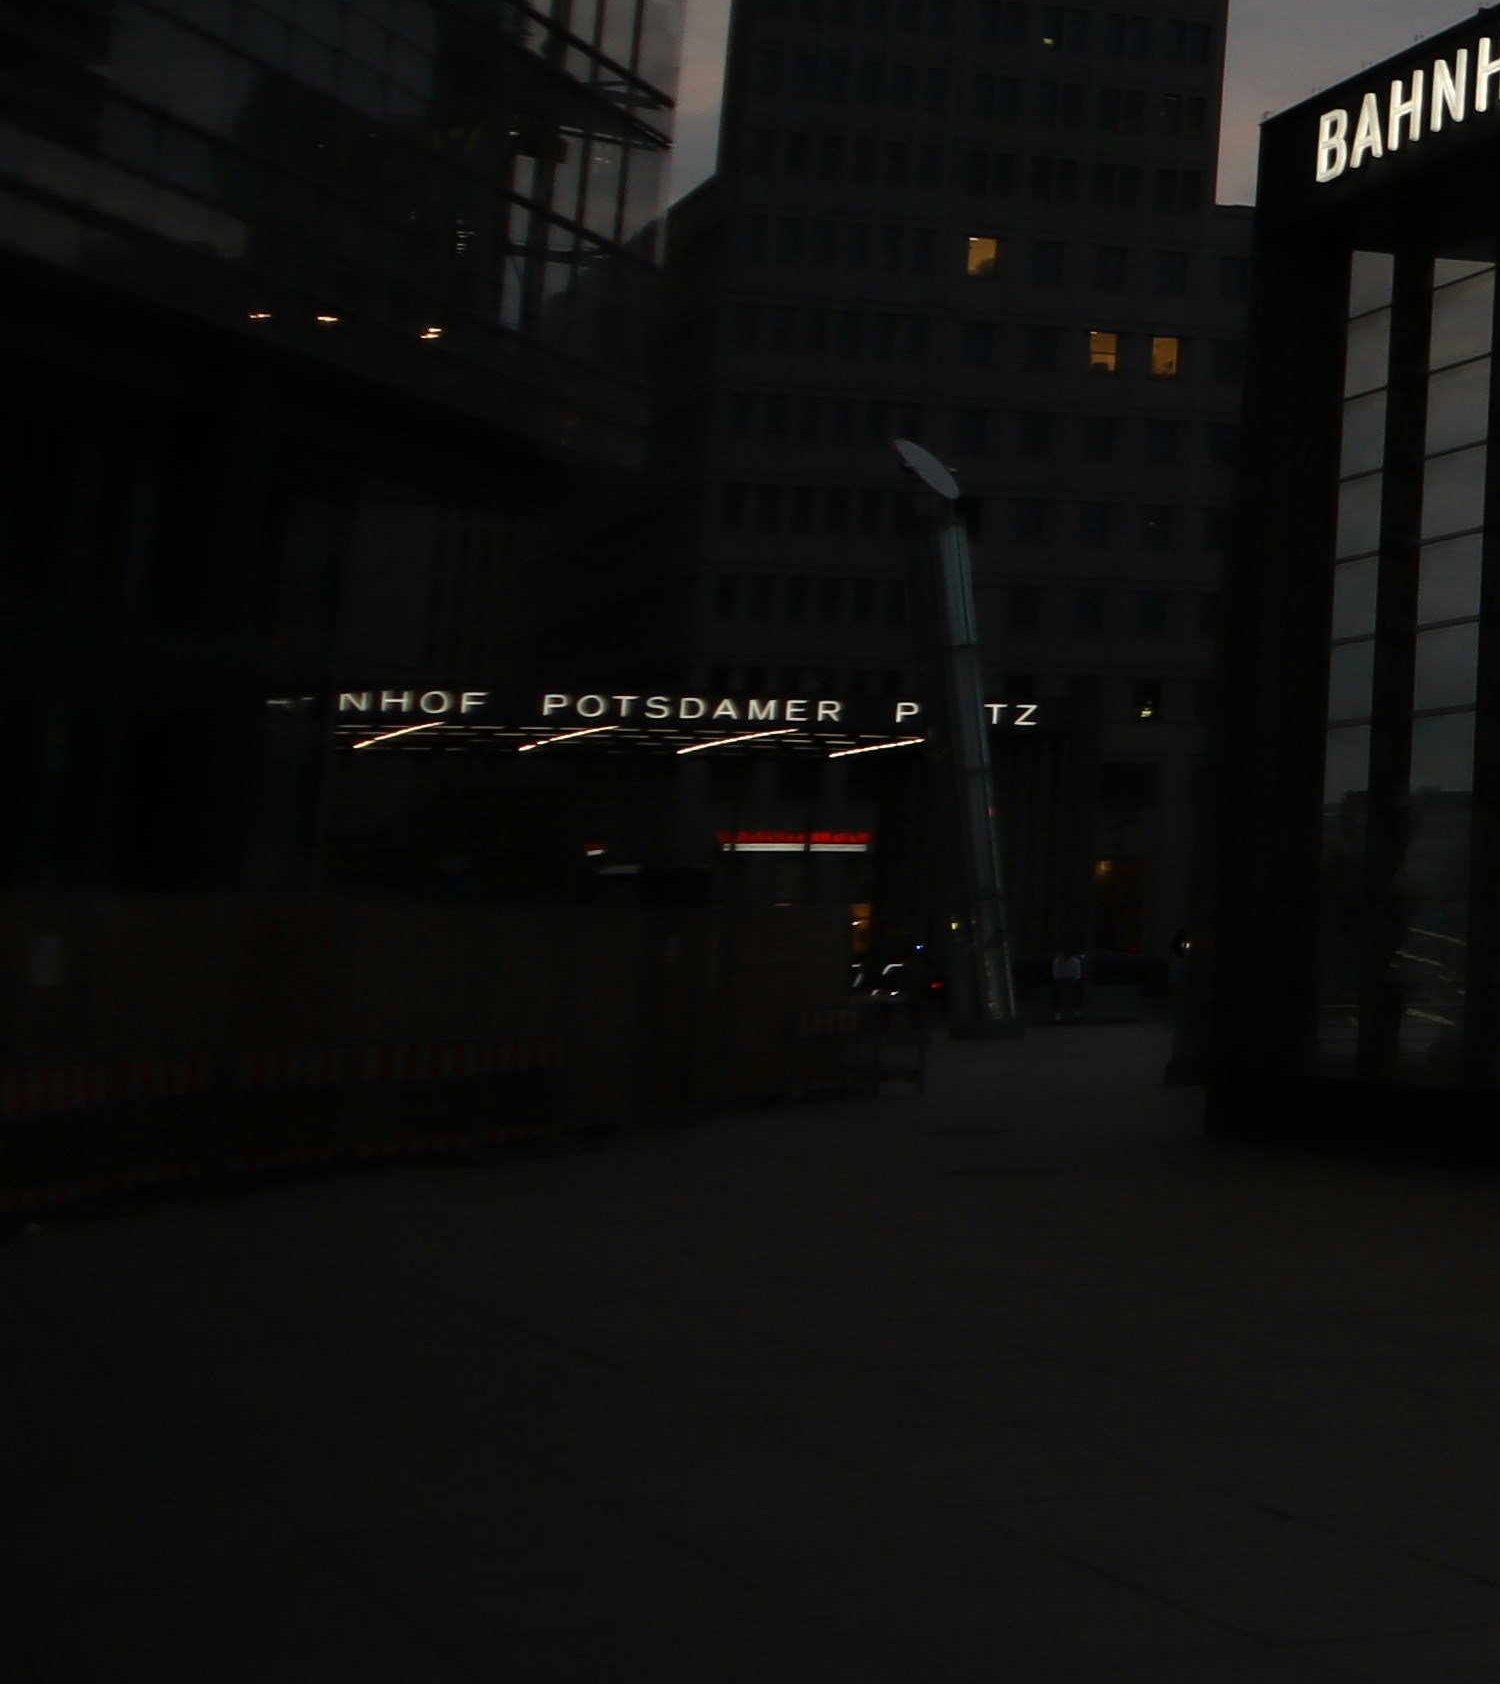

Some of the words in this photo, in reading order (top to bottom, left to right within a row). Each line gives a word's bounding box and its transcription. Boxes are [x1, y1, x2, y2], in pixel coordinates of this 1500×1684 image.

[266, 690, 490, 715] NHOF
[541, 692, 843, 723] POTSDAMER
[894, 700, 1040, 727] PTZ
